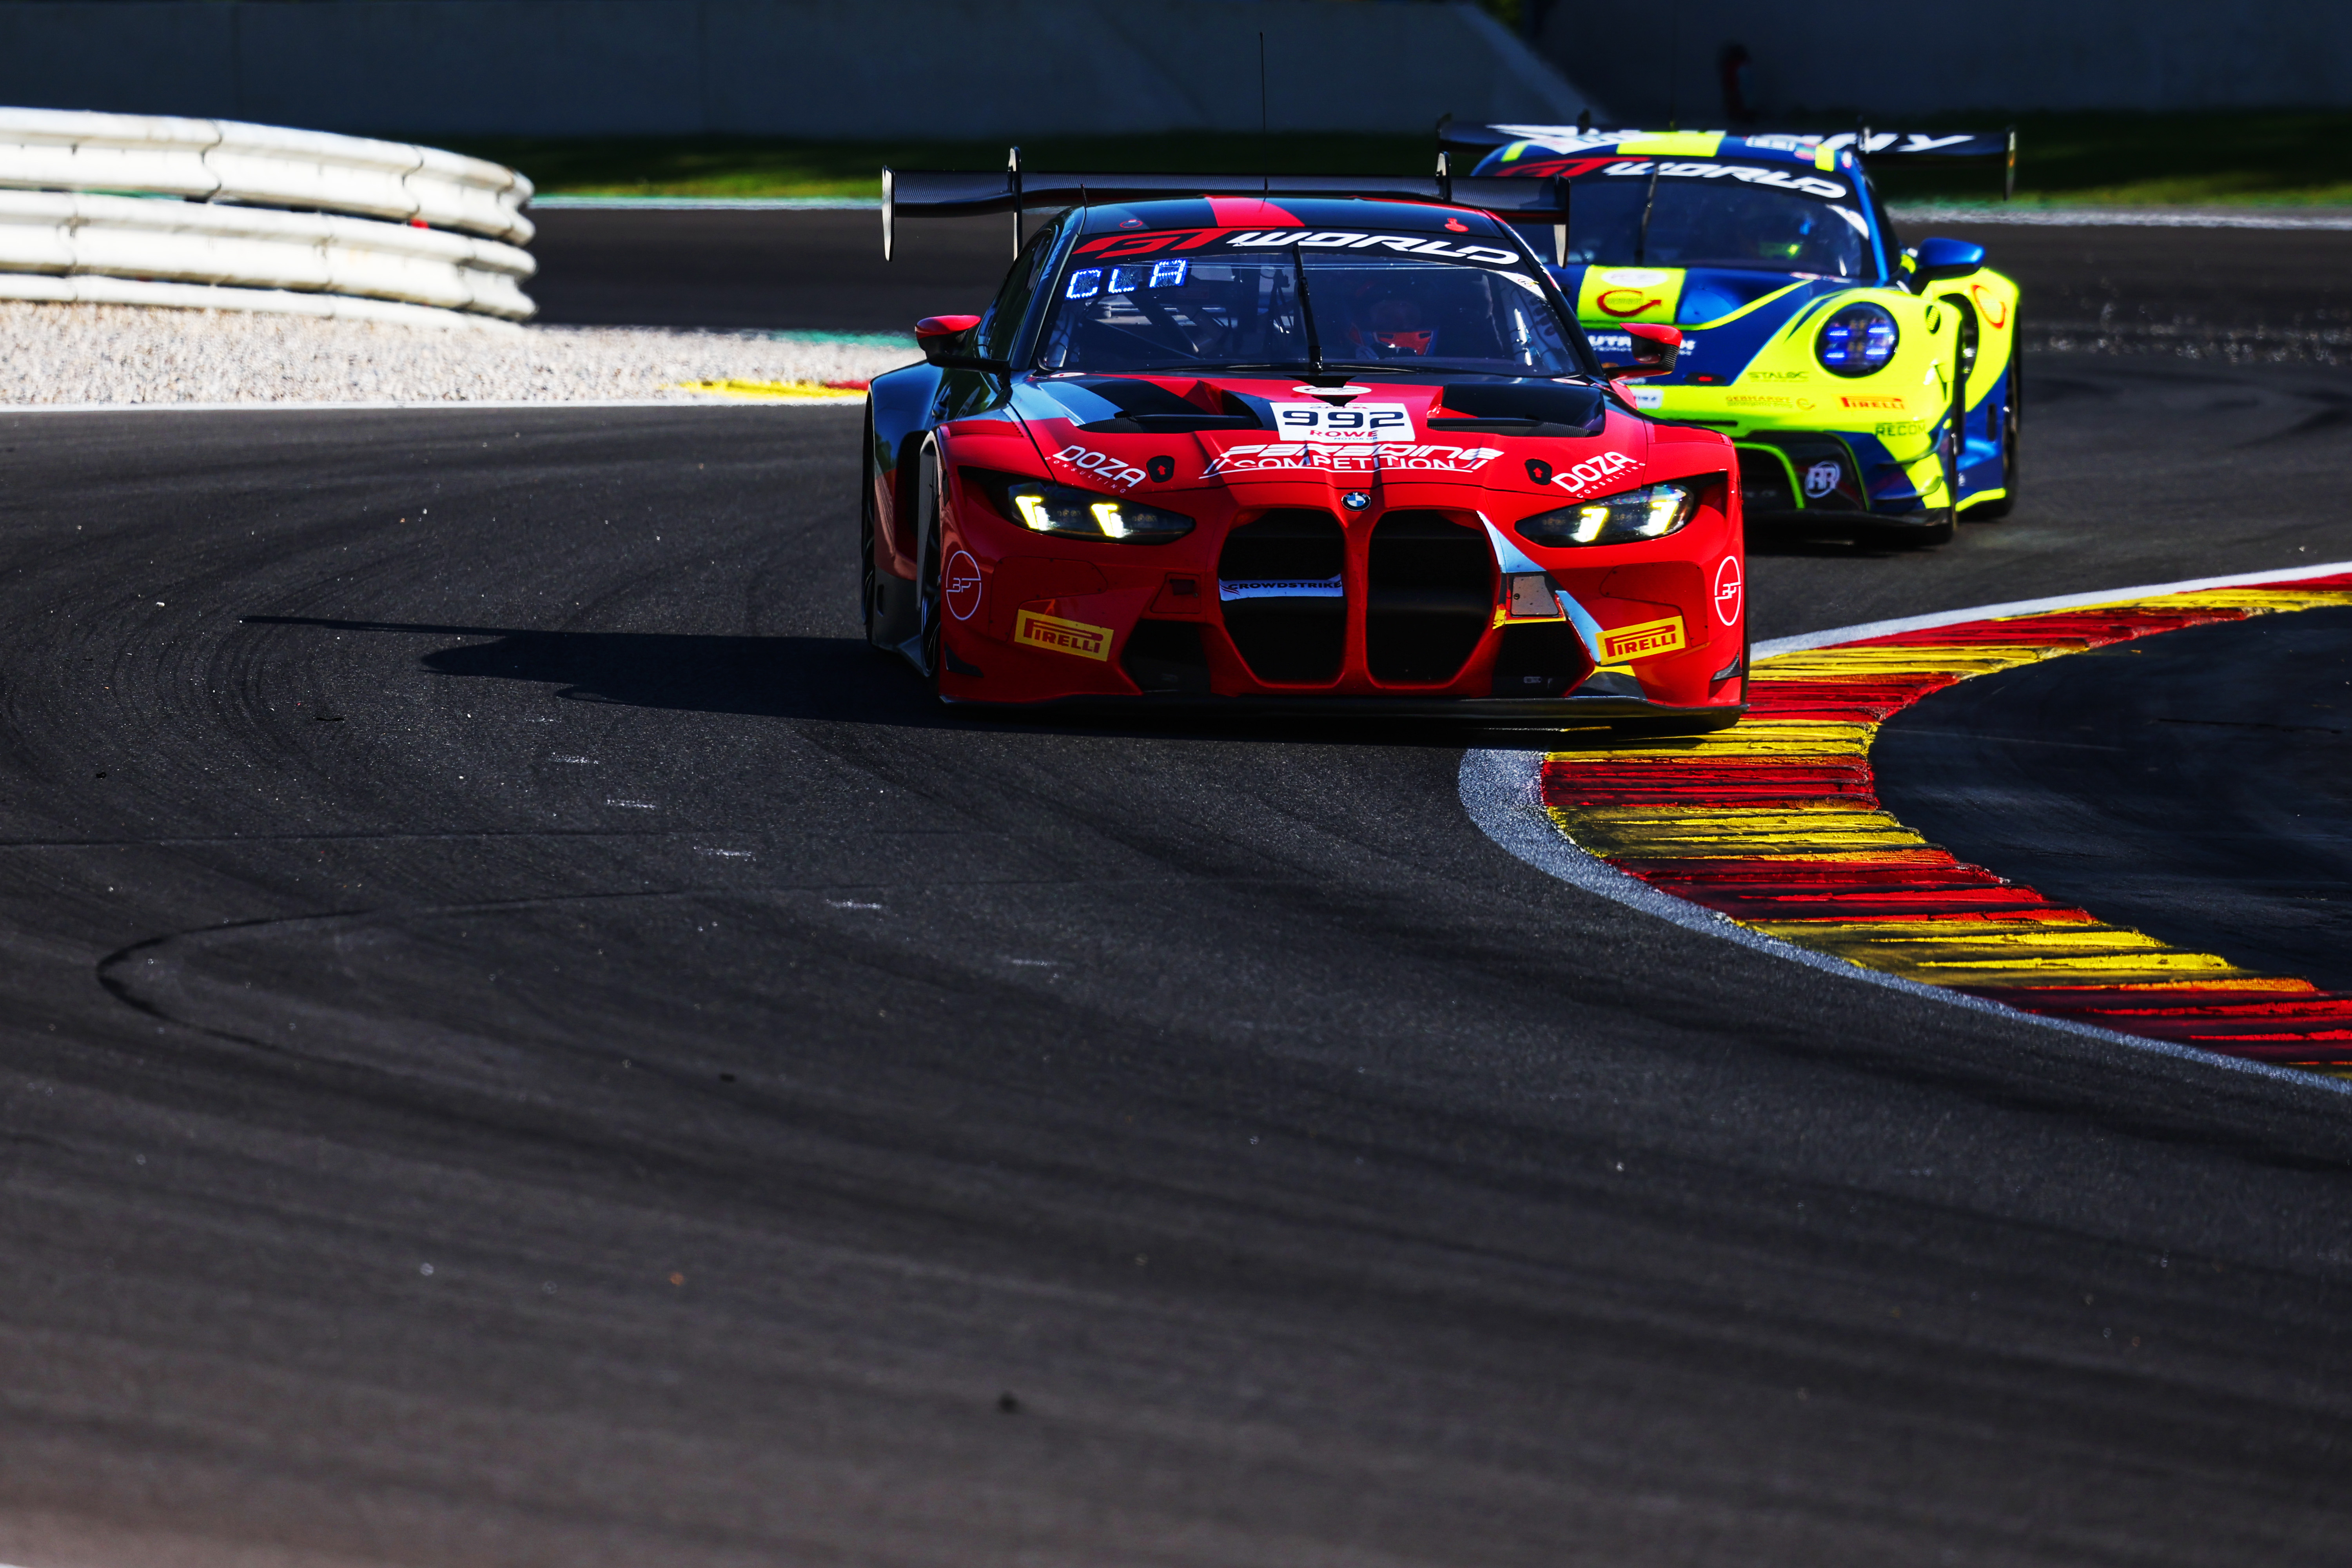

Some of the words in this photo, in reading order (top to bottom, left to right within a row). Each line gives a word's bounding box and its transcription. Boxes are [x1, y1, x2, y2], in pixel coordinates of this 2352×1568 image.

[1602, 162, 1846, 198] WORLD
[1071, 227, 1276, 259] GT
[1226, 232, 1520, 265] WORLD
[1283, 410, 1405, 428] 992
[1840, 397, 1904, 409] PIRELLI
[1875, 424, 1925, 436] RECOM
[1044, 456, 1126, 493] CONSULTING
[1052, 445, 1146, 487] DOZA
[1234, 455, 1454, 470] COMPETITION
[1550, 451, 1637, 493] DOZA
[1576, 463, 1646, 498] CONSULTING
[1228, 580, 1342, 589] CROWDSTRIKE
[1023, 617, 1103, 653] PIRELLI
[1604, 624, 1677, 657] PIRELLI
